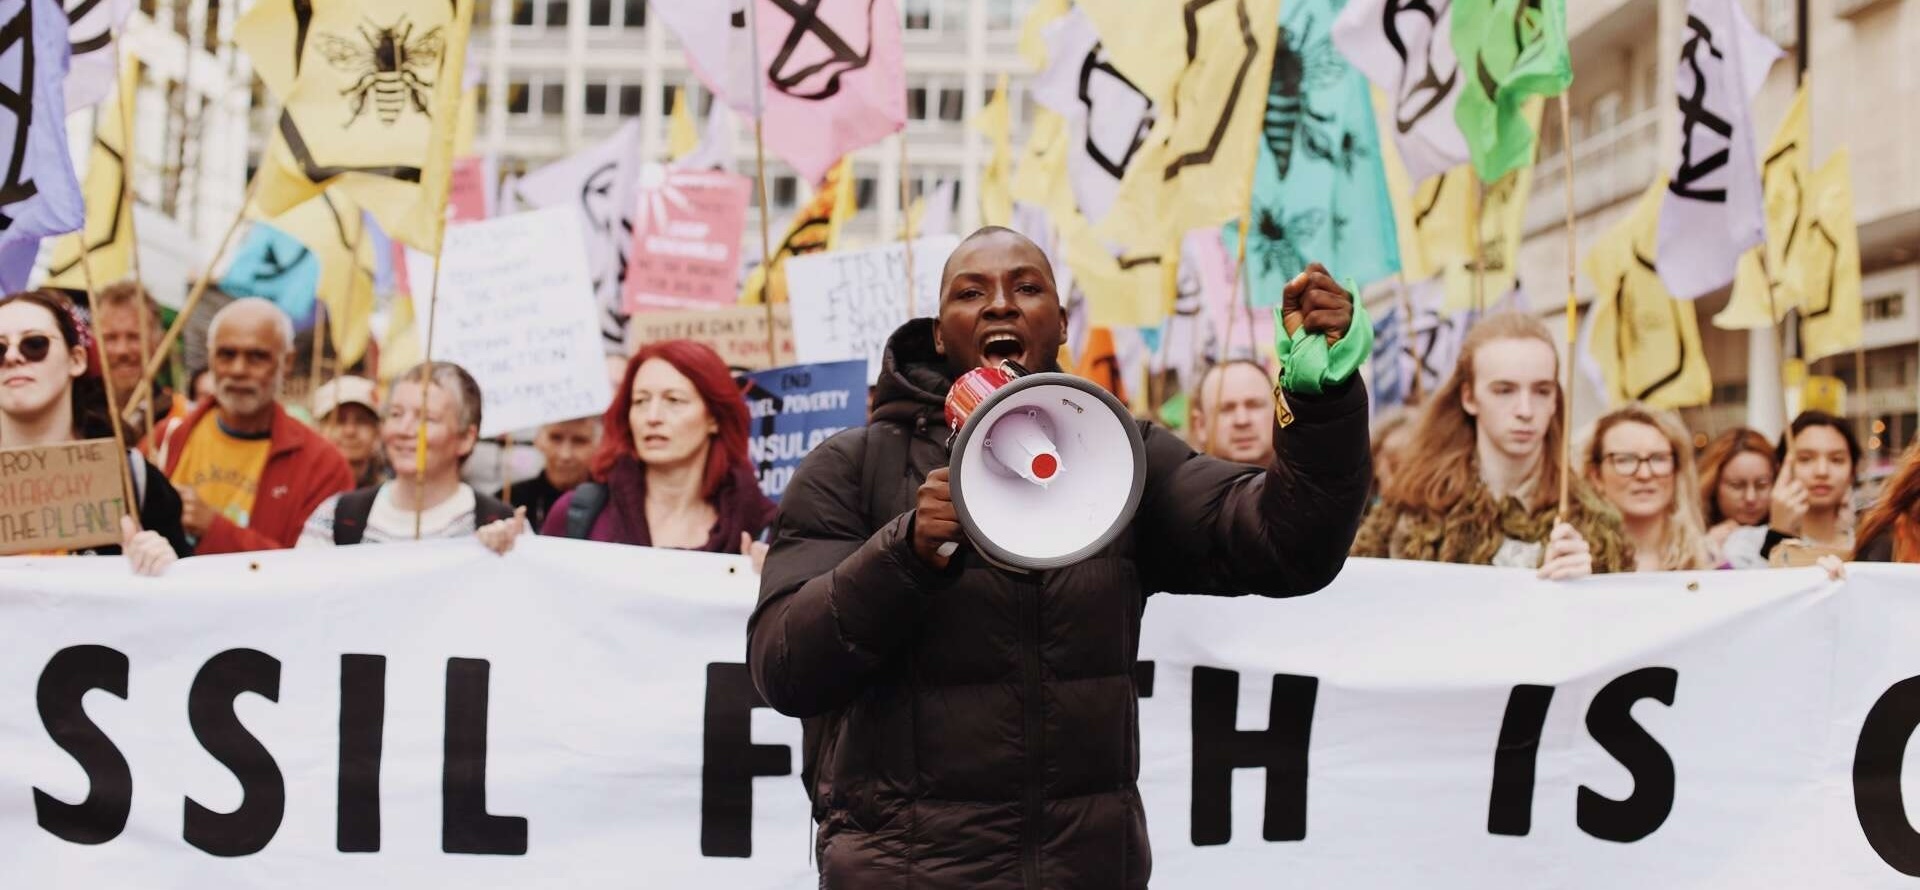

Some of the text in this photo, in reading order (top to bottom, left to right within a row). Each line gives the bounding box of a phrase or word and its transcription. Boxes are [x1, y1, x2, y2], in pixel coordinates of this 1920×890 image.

[781, 372, 812, 391] END
[782, 389, 851, 415] POVERTY
[0, 443, 102, 477] ROY THE
[0, 498, 122, 541] THE PLANET
[32, 644, 528, 857] SSIL
[1487, 667, 1679, 844] IS
